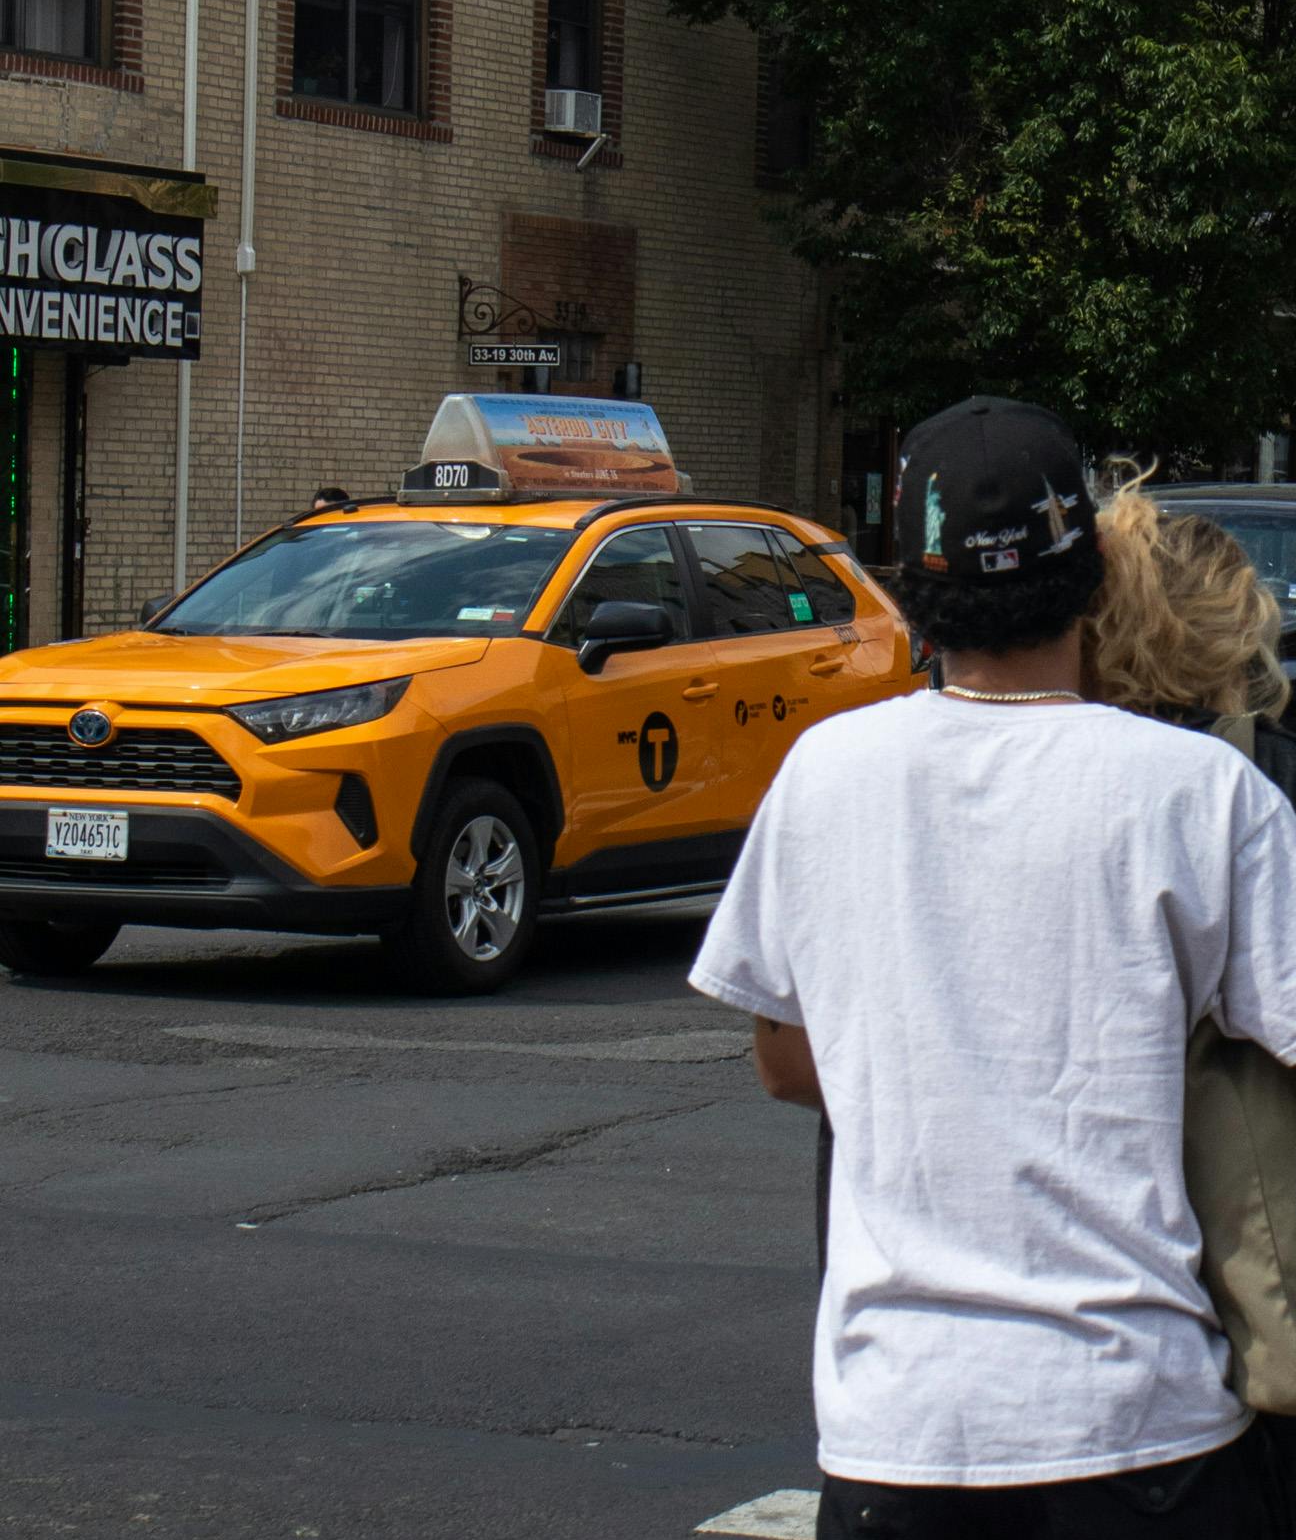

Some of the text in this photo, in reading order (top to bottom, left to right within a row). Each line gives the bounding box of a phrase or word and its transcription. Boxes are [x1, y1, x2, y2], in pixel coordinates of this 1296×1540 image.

[0, 217, 202, 293] H CLASS
[474, 348, 556, 362] 33-19 30th Av.
[435, 464, 469, 487] 8D70
[965, 525, 1029, 548] New York
[617, 728, 670, 782] NYC T
[69, 812, 109, 822] NEW YORK
[55, 822, 121, 849] Y204651C
